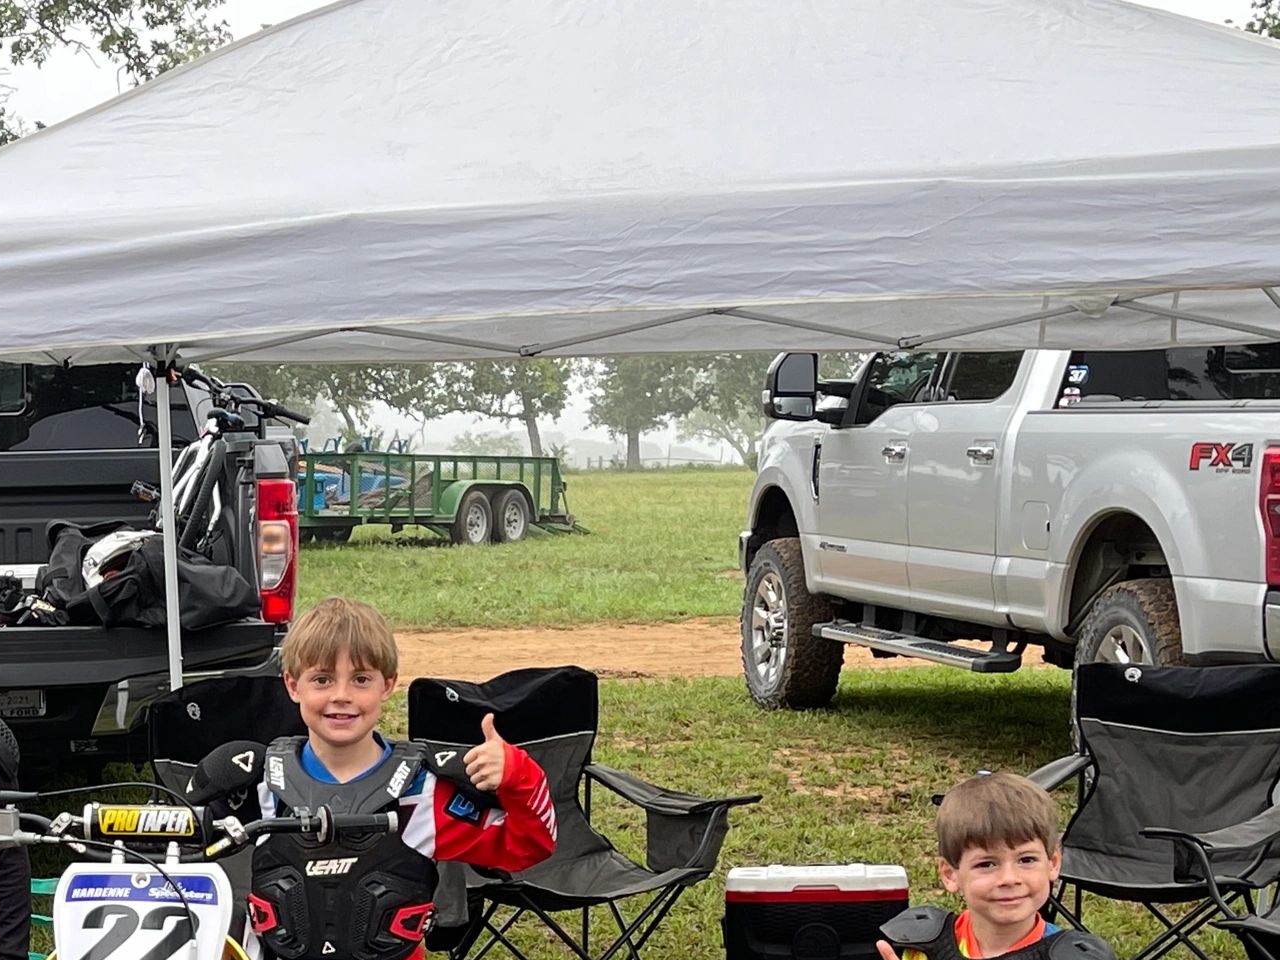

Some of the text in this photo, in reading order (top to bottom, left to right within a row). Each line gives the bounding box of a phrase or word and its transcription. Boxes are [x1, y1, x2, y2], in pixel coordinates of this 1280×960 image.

[1069, 369, 1087, 381] 37
[1189, 442, 1253, 470] FX4
[270, 756, 285, 790] LEATT
[386, 760, 412, 798] LEATT
[103, 808, 190, 834] PROTAPER
[305, 857, 359, 876] LEATT
[72, 887, 131, 898] HARDENNE
